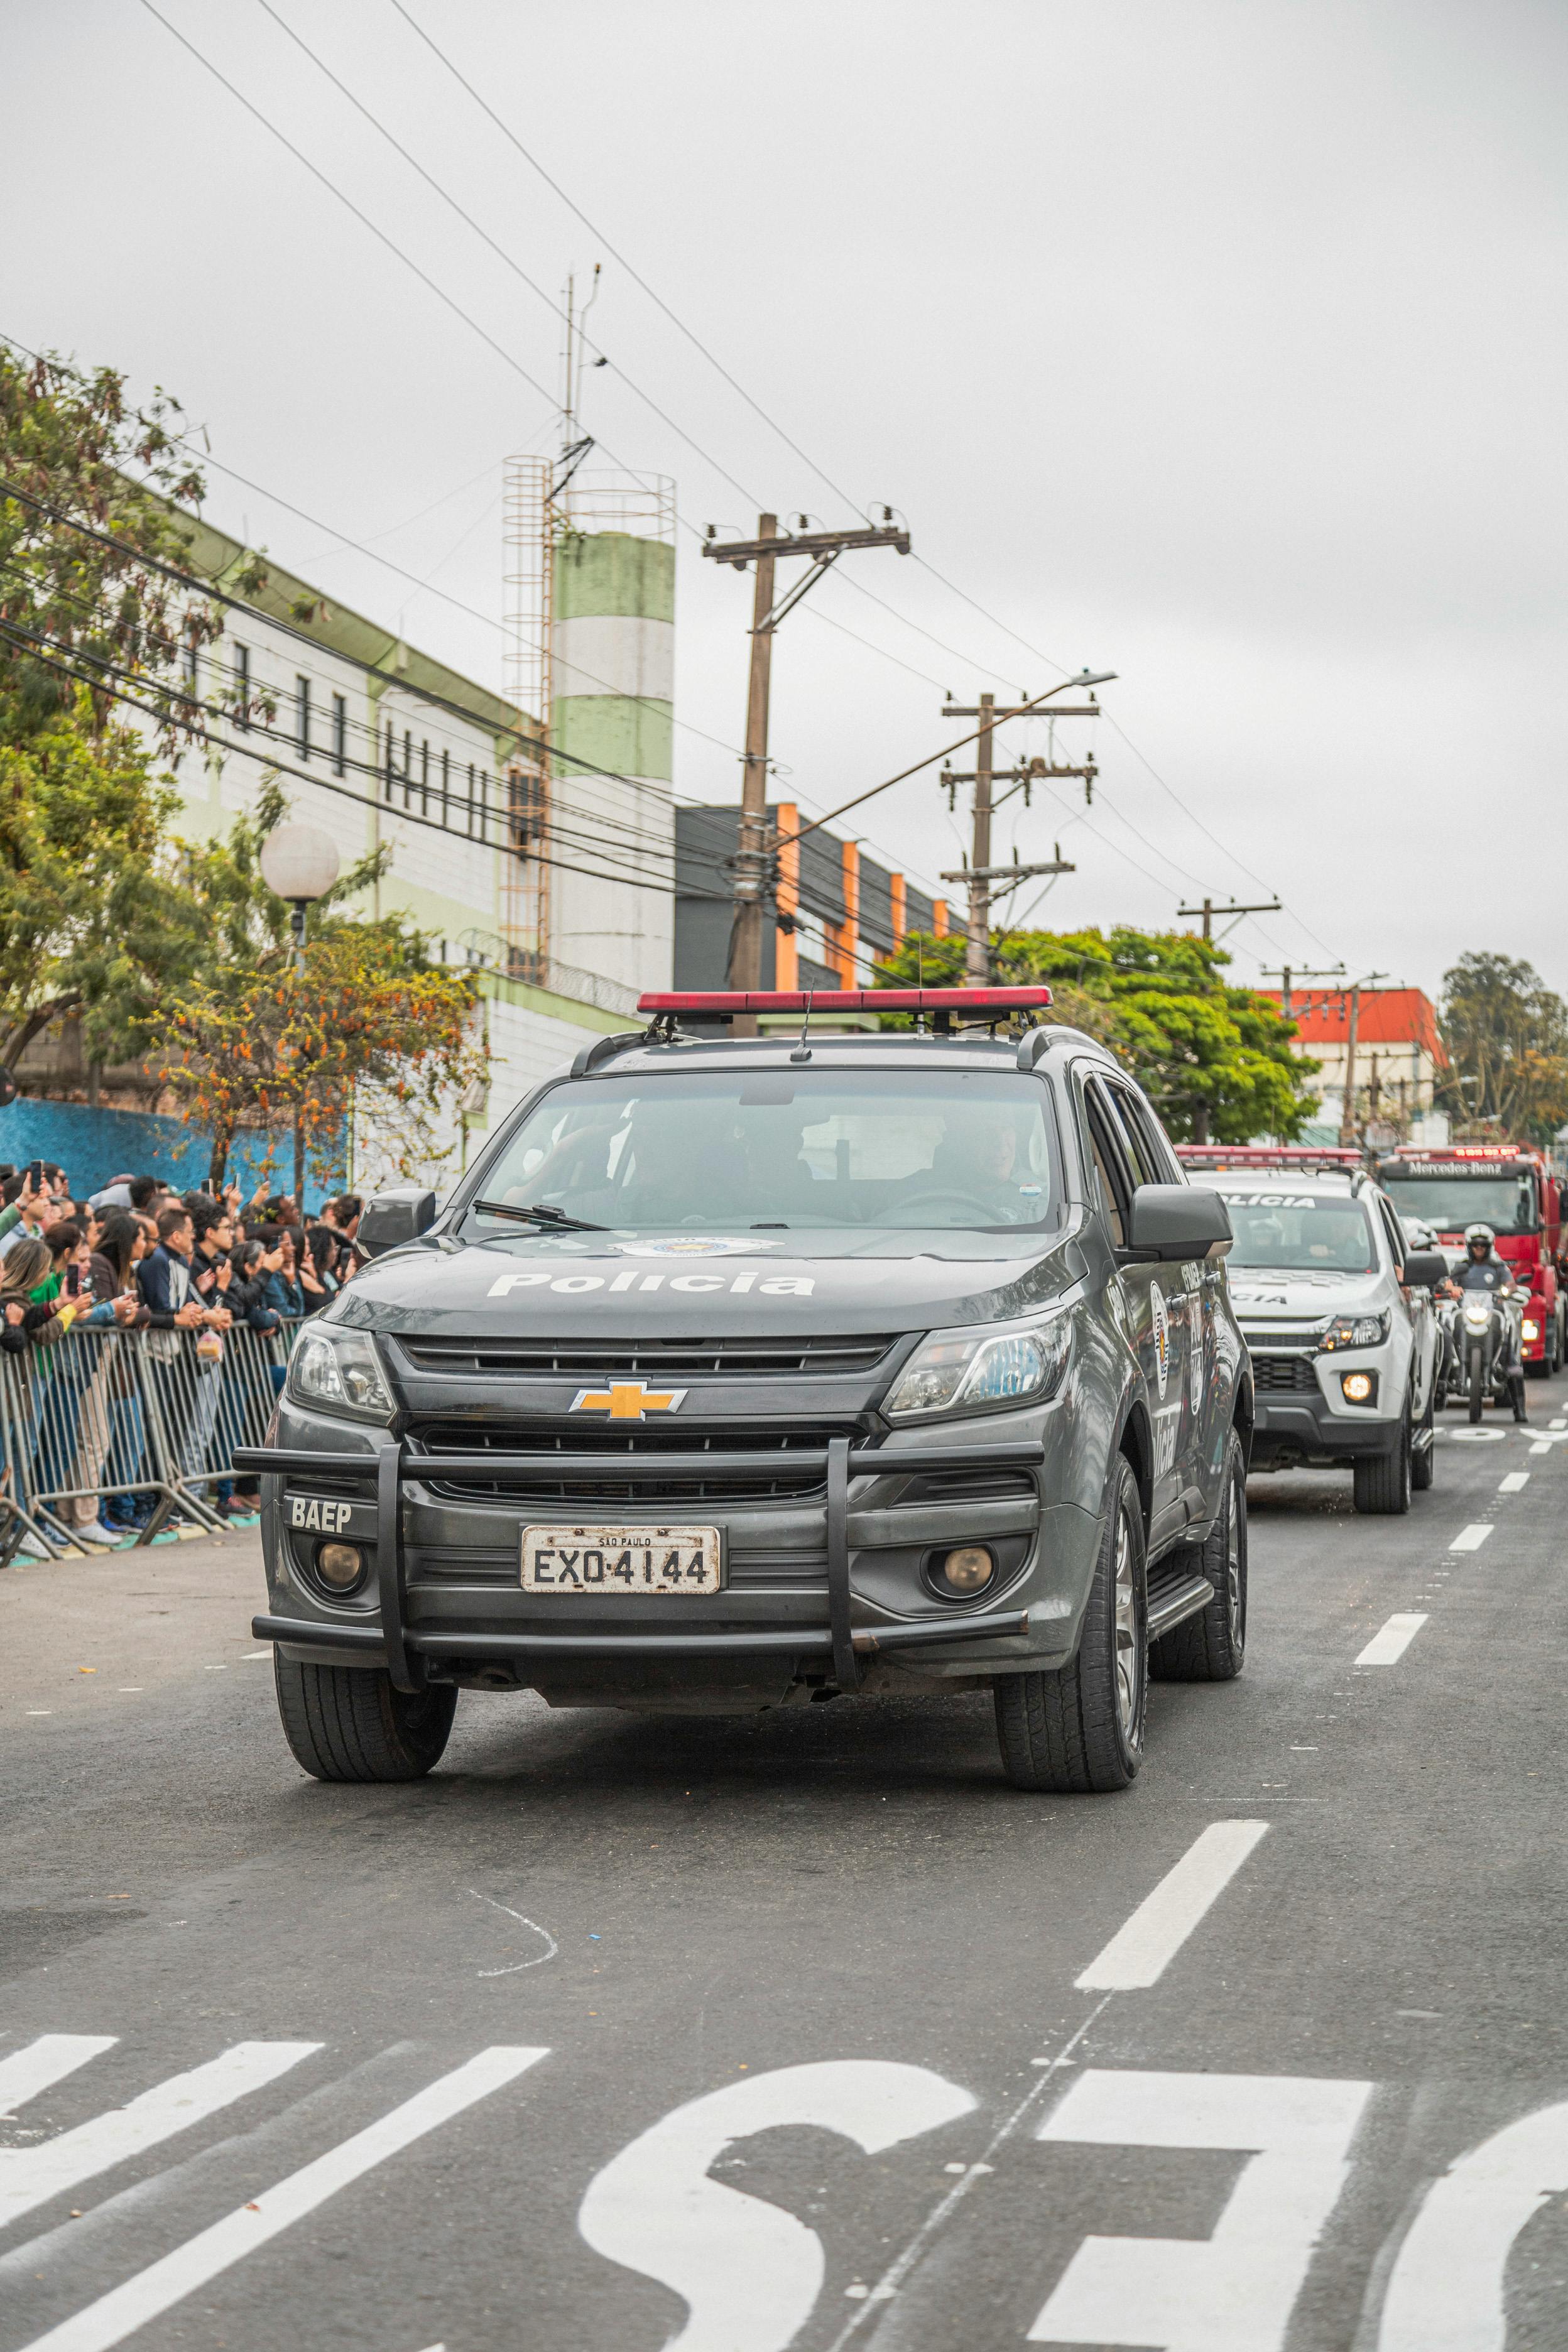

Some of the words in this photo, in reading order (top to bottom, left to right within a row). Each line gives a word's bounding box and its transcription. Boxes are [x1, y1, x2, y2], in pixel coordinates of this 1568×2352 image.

[1408, 1162, 1502, 1175] Mercedes-Benz
[292, 1498, 351, 1533] BAEP
[621, 1538, 651, 1546] PAULO
